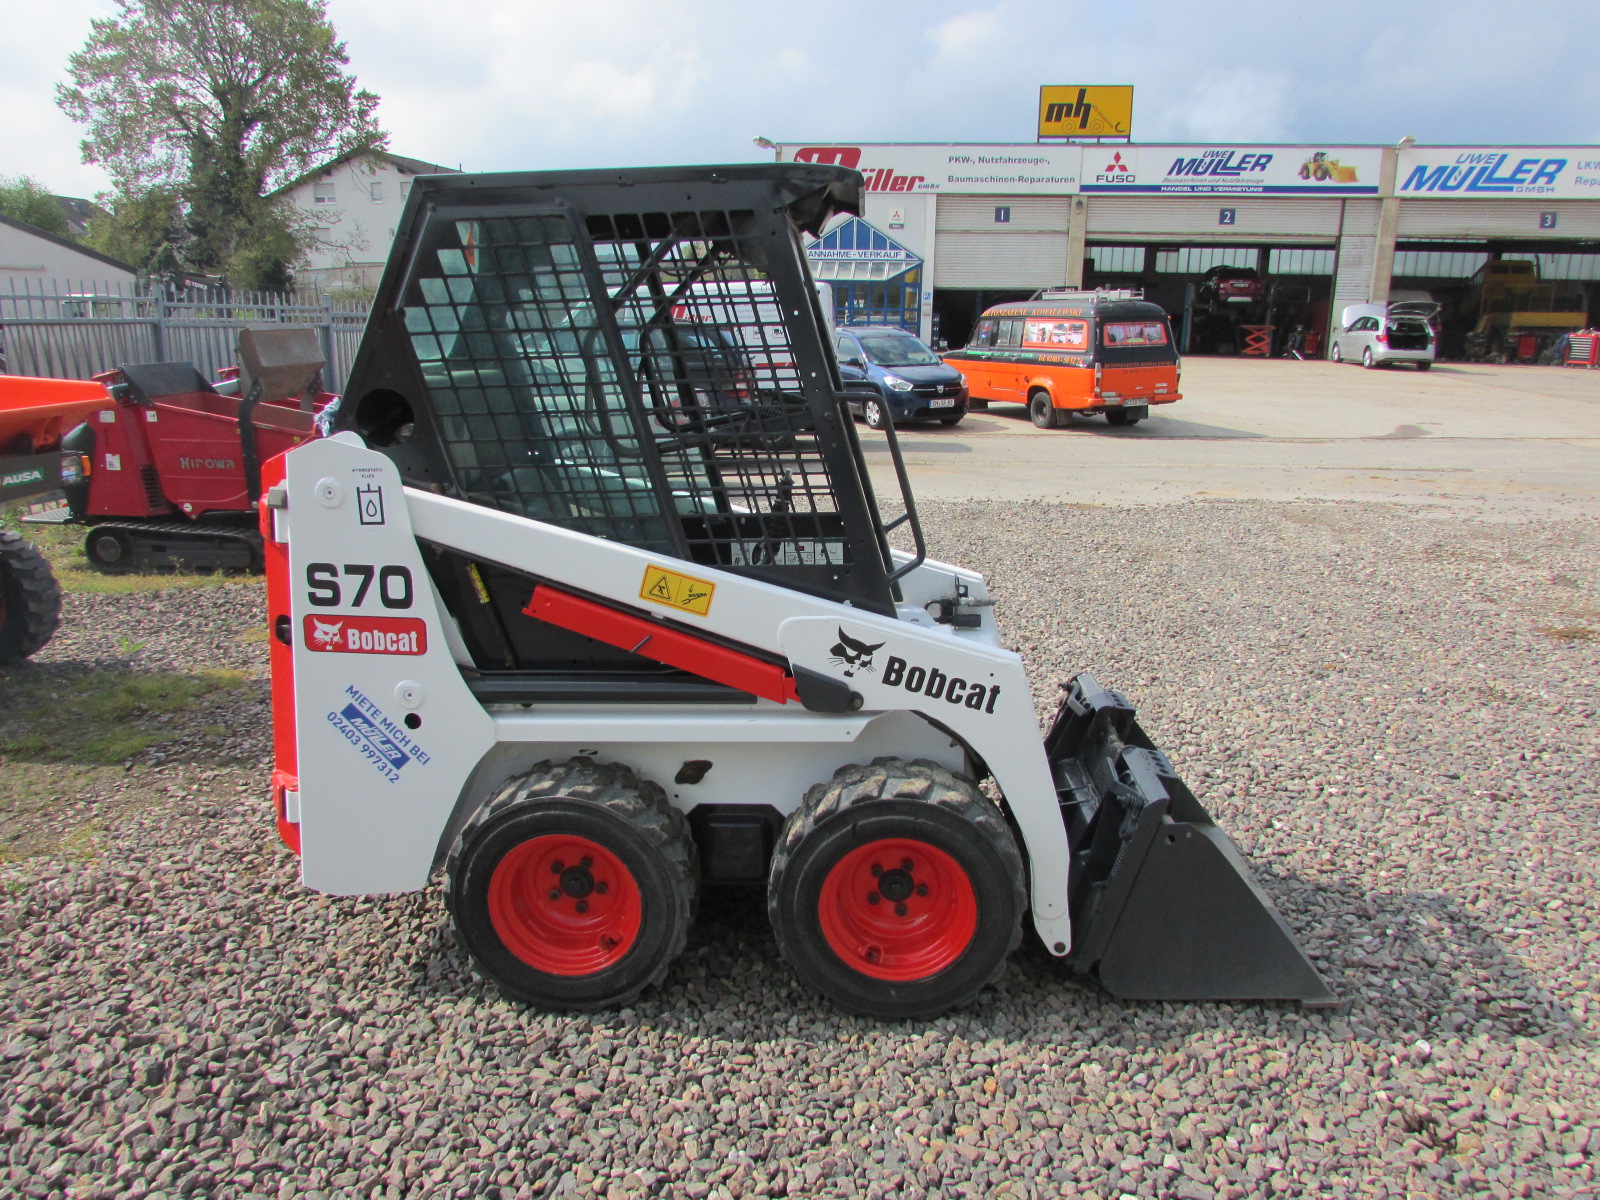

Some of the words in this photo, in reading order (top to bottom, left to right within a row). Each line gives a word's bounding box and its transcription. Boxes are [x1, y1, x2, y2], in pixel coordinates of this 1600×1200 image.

[1166, 150, 1274, 177] MÜLLER
[1202, 150, 1229, 159] UWE
[1455, 153, 1499, 165] UWE
[947, 175, 1076, 185] Baumaschinen-Reparaturen
[1096, 175, 1136, 183] FUSO
[1399, 153, 1568, 193] MÜLLER
[1223, 211, 1231, 223] 2
[1543, 214, 1552, 227] 3
[2, 470, 42, 486] AUSA
[306, 562, 414, 610] S70
[347, 628, 418, 652] Bobcat
[881, 655, 1001, 715] Bobcat
[345, 684, 382, 720] MIETE
[379, 716, 411, 747] MICH
[408, 744, 431, 766] BEI
[327, 711, 361, 746] 02403
[360, 743, 400, 784] 997312
